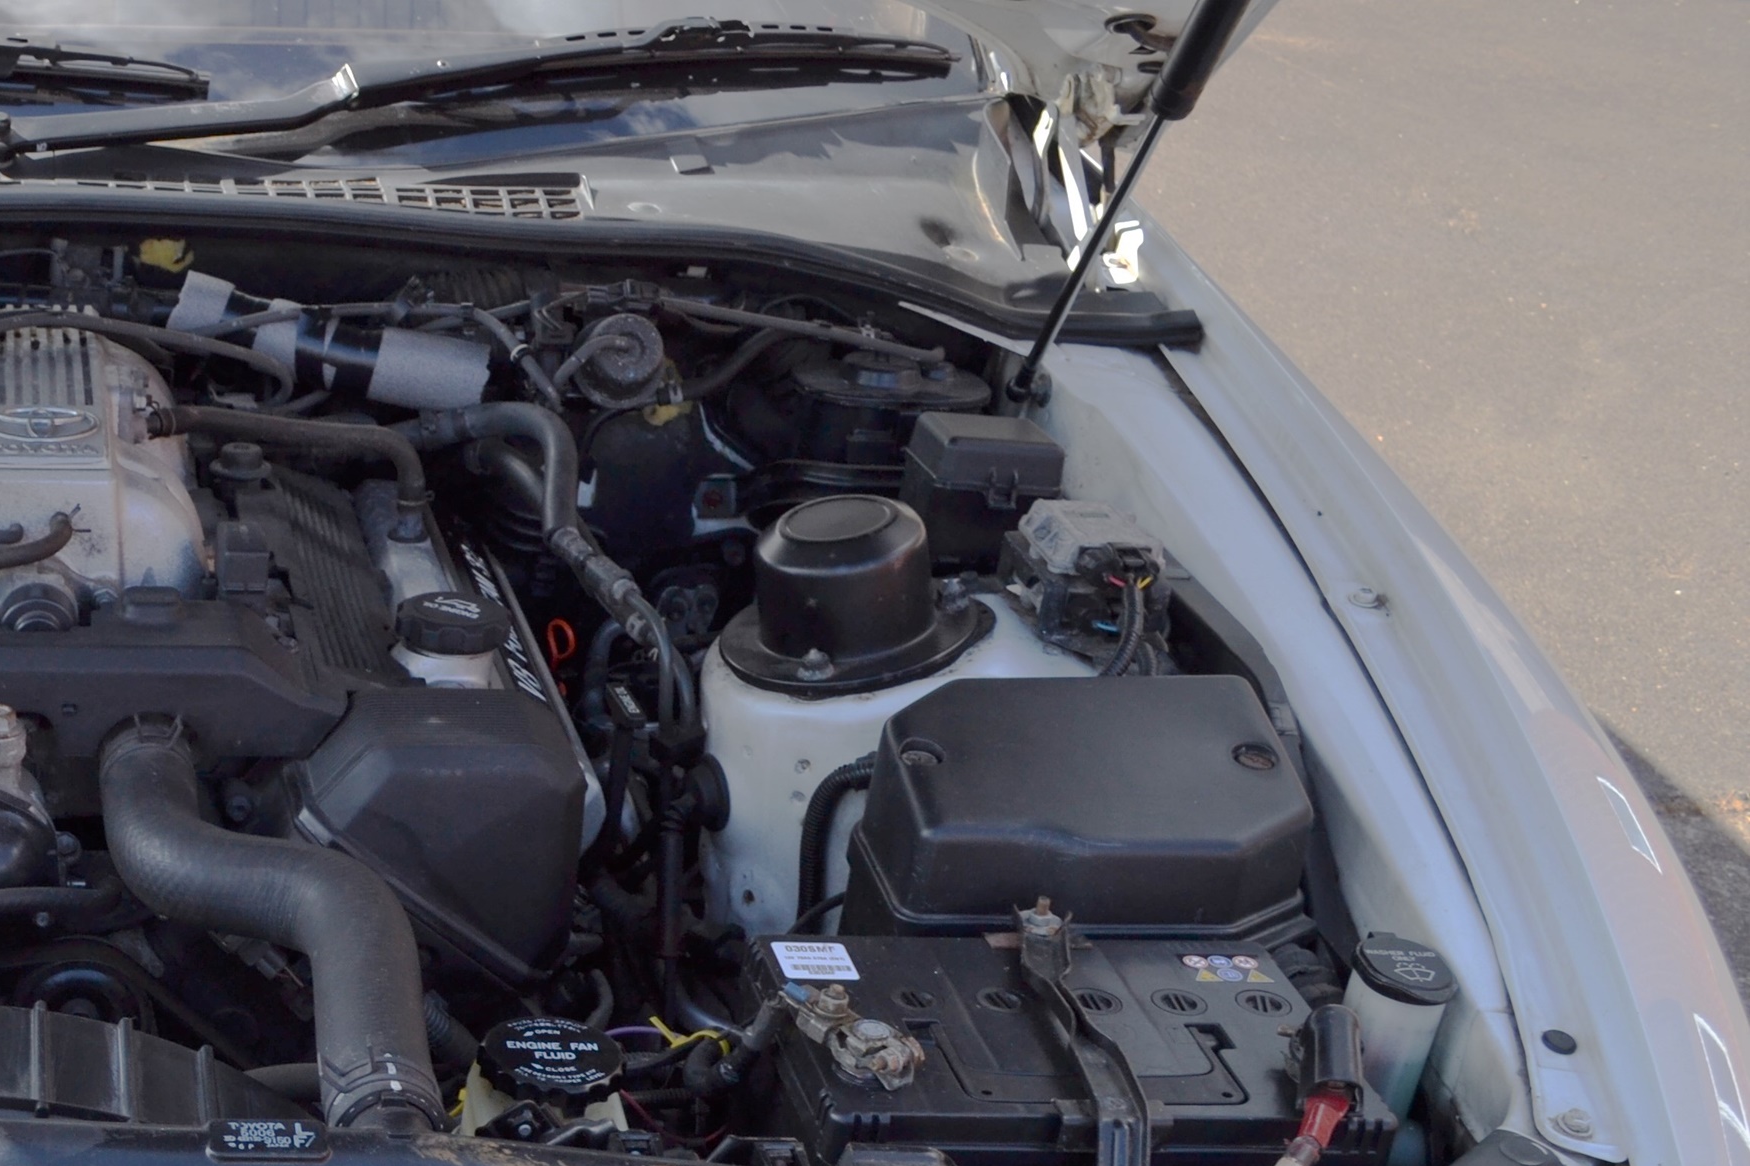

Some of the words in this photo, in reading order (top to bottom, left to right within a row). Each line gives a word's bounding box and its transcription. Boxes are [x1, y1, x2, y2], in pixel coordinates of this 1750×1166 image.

[506, 1041, 562, 1050] ENGINE
[570, 1042, 599, 1051] FAN
[534, 1051, 577, 1060] FLUID
